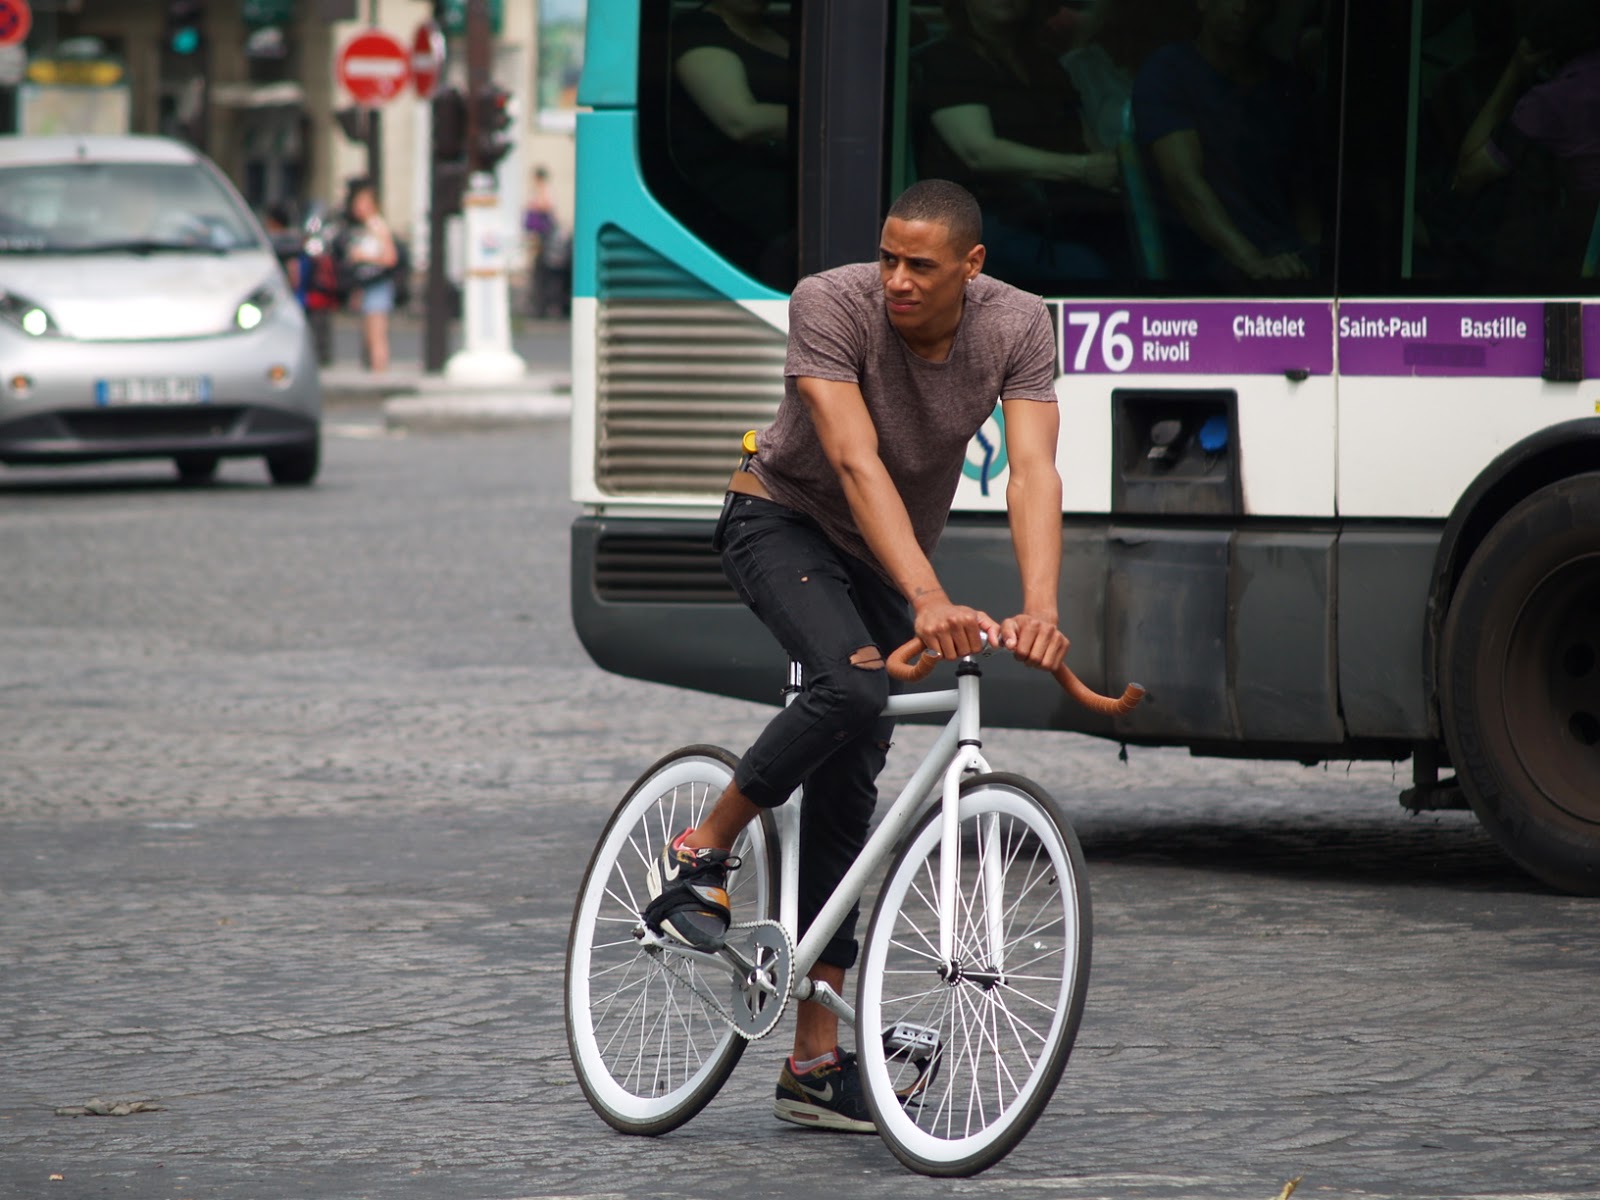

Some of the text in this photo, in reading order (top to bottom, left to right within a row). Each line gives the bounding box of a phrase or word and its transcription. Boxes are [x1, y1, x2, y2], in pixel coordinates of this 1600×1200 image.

[1143, 317, 1198, 336] Louvre
[1233, 315, 1305, 337] Châtelet
[1340, 317, 1427, 338] Saint-Paul
[1460, 317, 1527, 338] Bastille
[1069, 310, 1134, 372] 76
[1143, 341, 1189, 362] Rivoli
